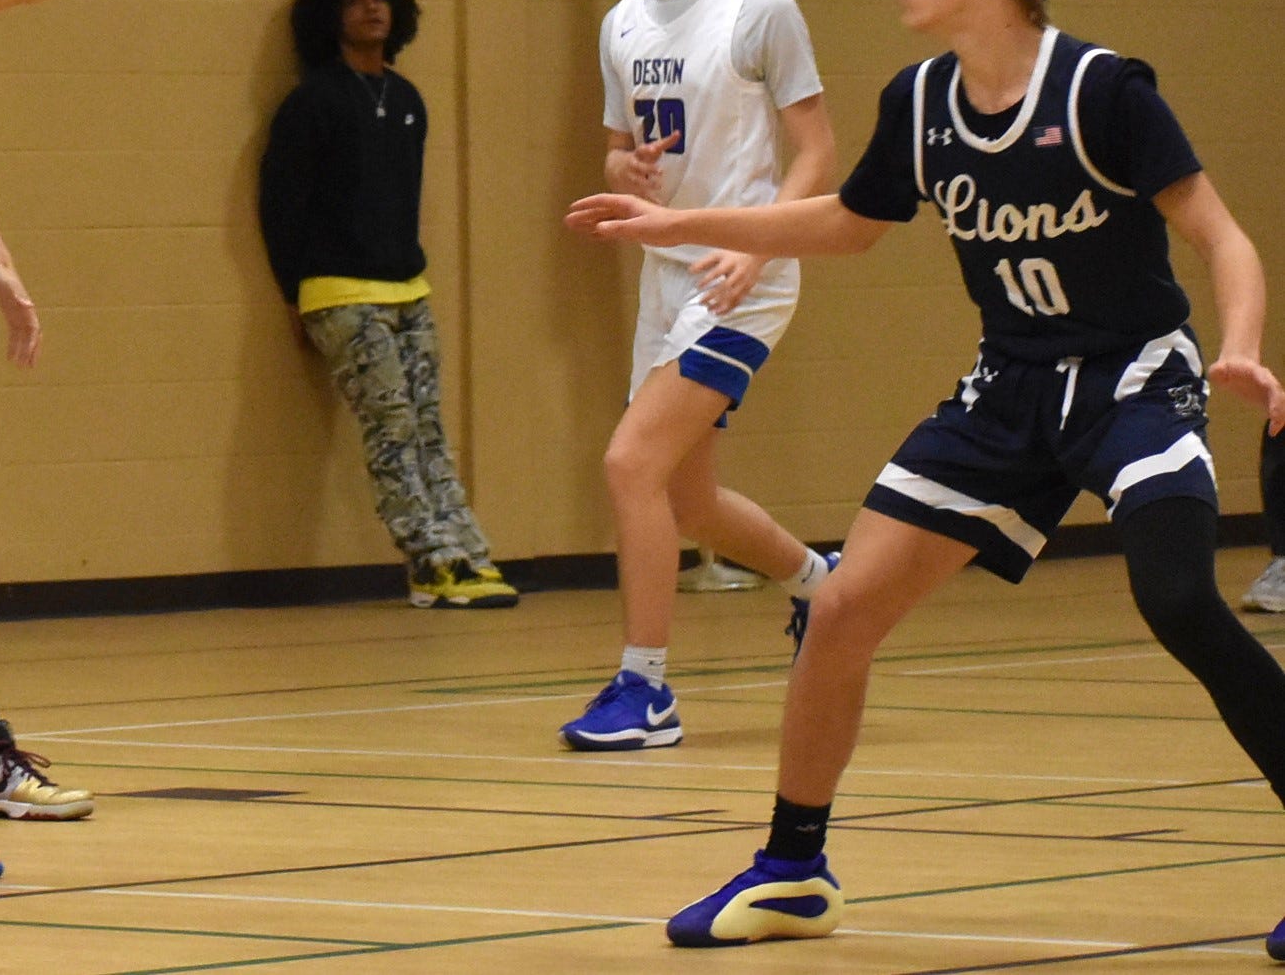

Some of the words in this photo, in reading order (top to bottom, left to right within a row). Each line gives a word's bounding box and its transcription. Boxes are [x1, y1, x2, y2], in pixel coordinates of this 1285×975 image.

[633, 58, 685, 86] DESTIN
[934, 174, 1110, 242] Lions
[993, 257, 1071, 317] 10
